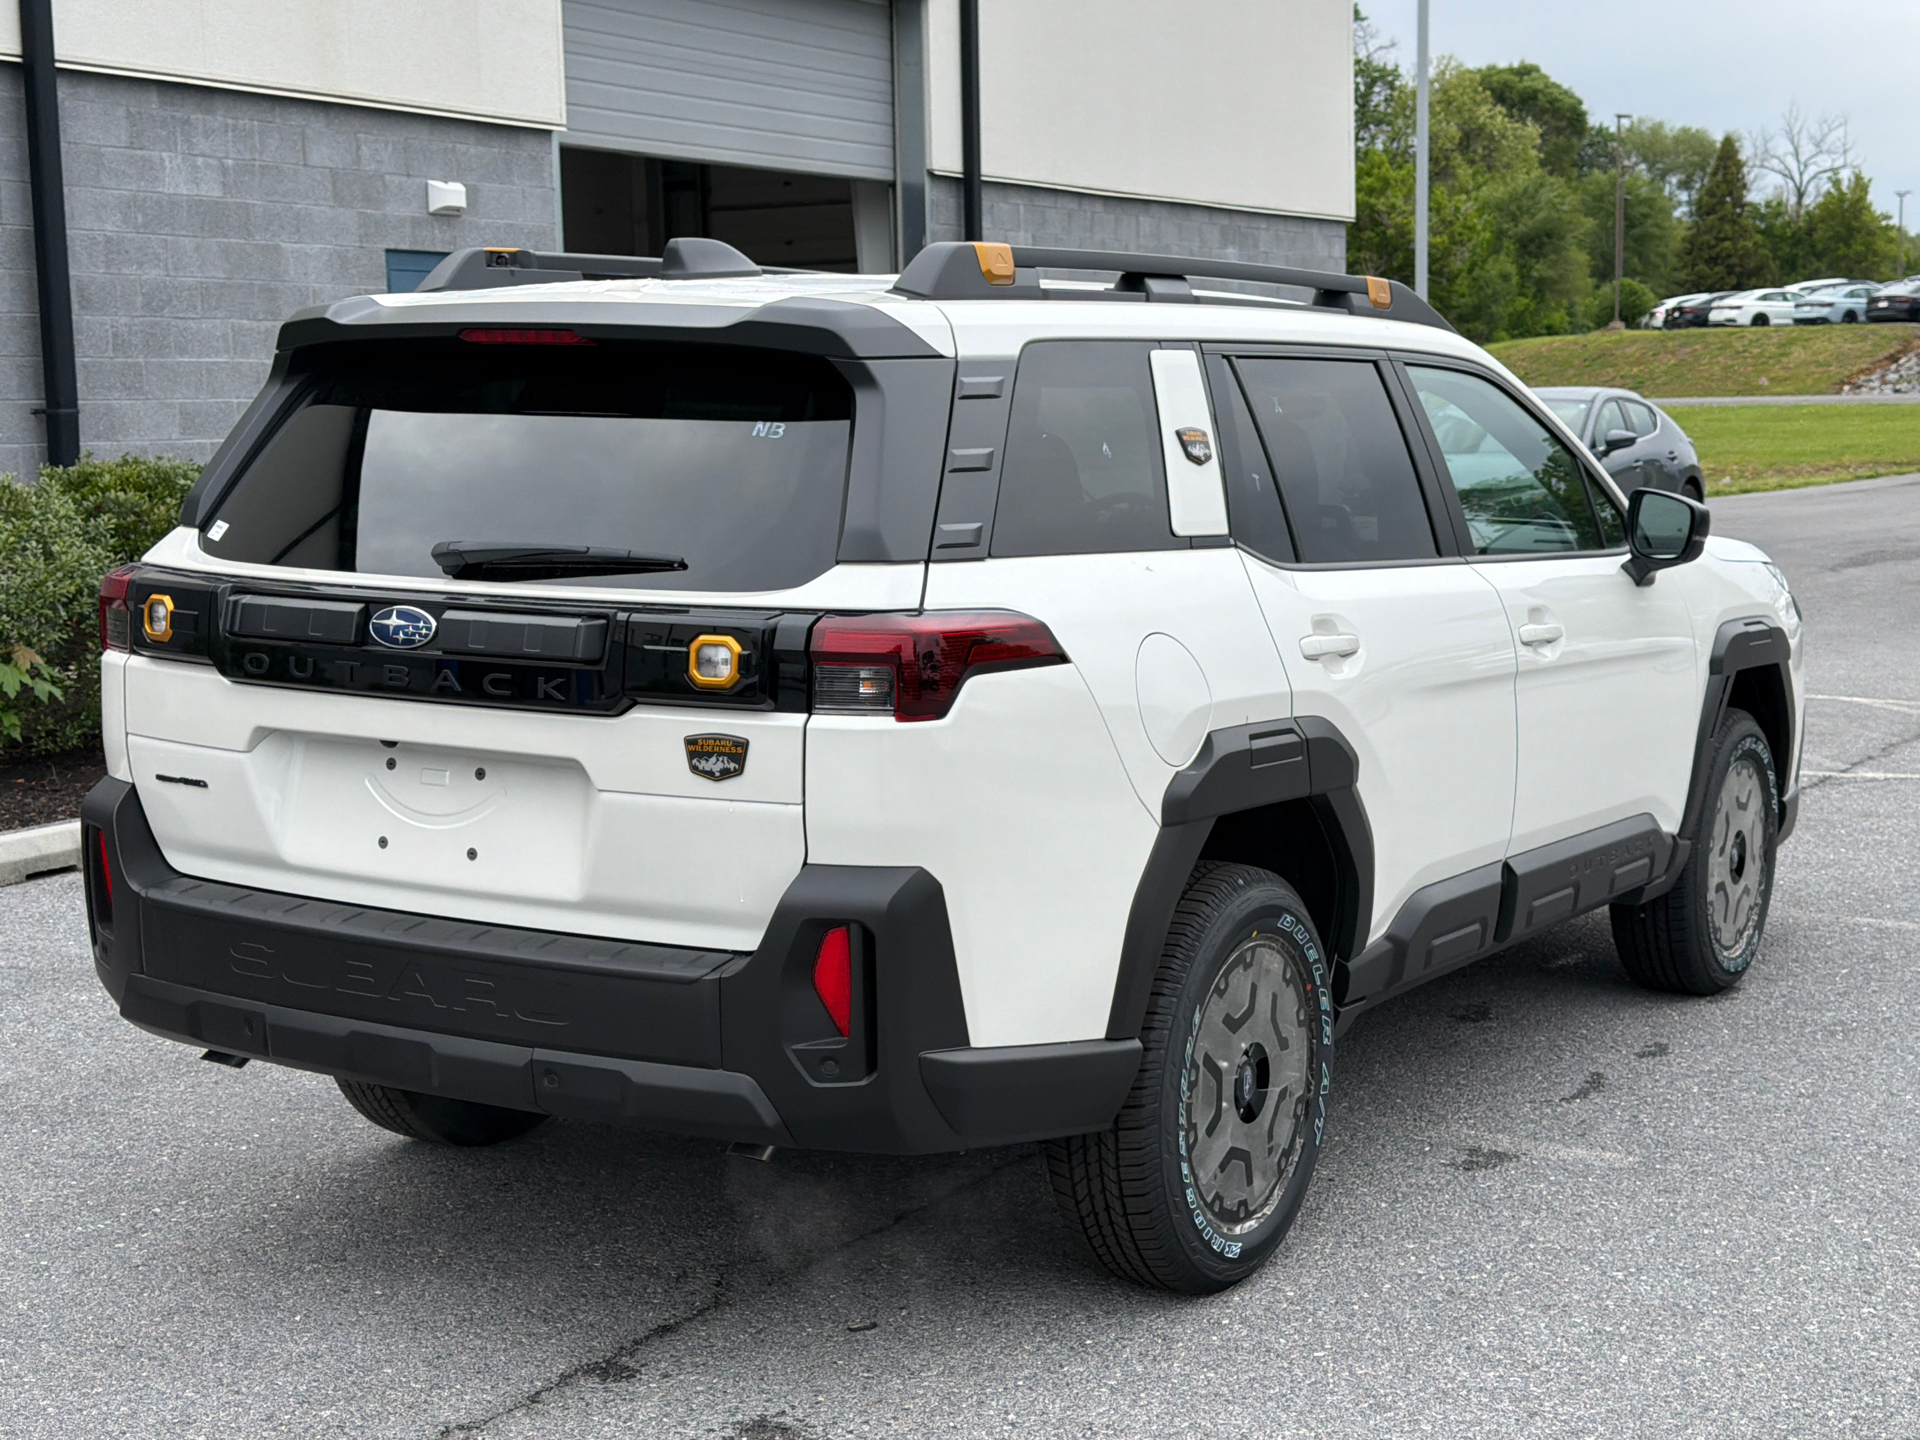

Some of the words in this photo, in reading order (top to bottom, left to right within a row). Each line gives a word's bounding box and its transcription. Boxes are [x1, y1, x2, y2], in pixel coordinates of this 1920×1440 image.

[752, 421, 786, 439] NB
[243, 651, 567, 701] OUTBACK
[688, 744, 743, 753] WILDERNESS
[697, 738, 733, 747] SUBARU
[1277, 913, 1333, 1047] DUELER
[1313, 1061, 1331, 1147] A/T
[1178, 1004, 1244, 1260] BRIDGESTONE
